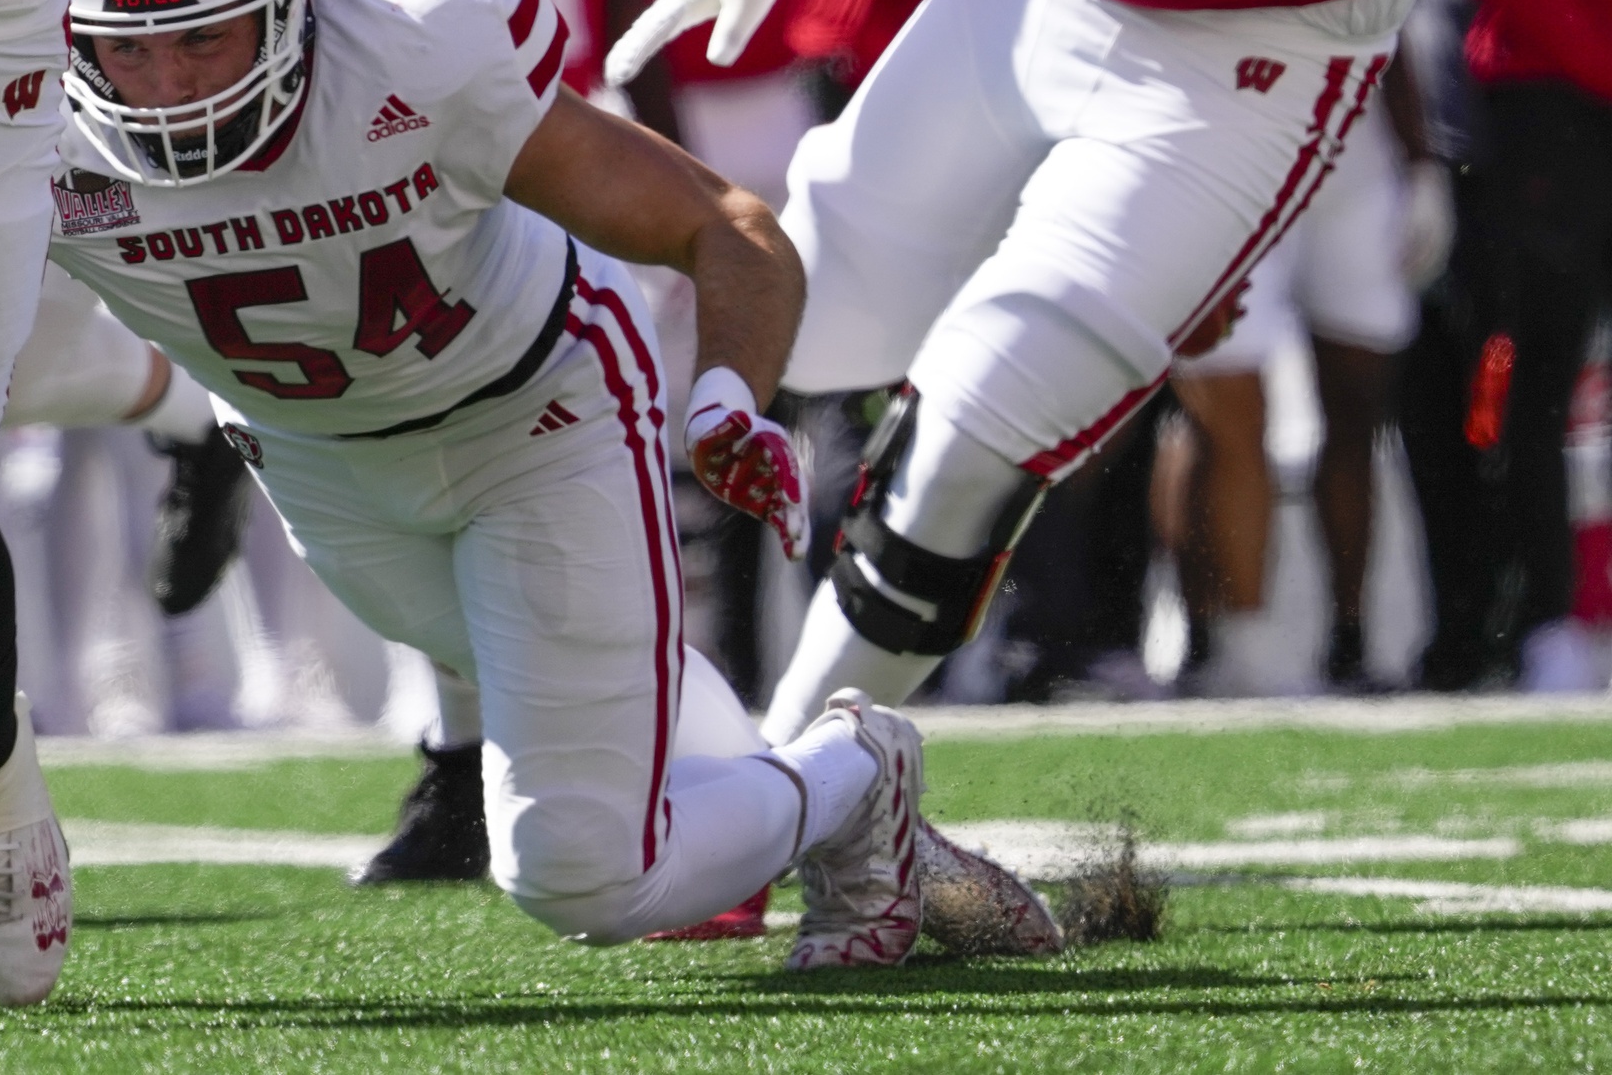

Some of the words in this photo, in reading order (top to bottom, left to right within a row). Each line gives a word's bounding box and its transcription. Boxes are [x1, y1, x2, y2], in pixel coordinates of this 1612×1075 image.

[2, 69, 47, 120] W
[1235, 57, 1287, 95] W
[367, 115, 431, 142] adidas
[54, 180, 134, 223] VALLEY
[117, 215, 265, 264] SOUTH
[270, 161, 439, 245] DAKOTA
[184, 236, 477, 400] 54
